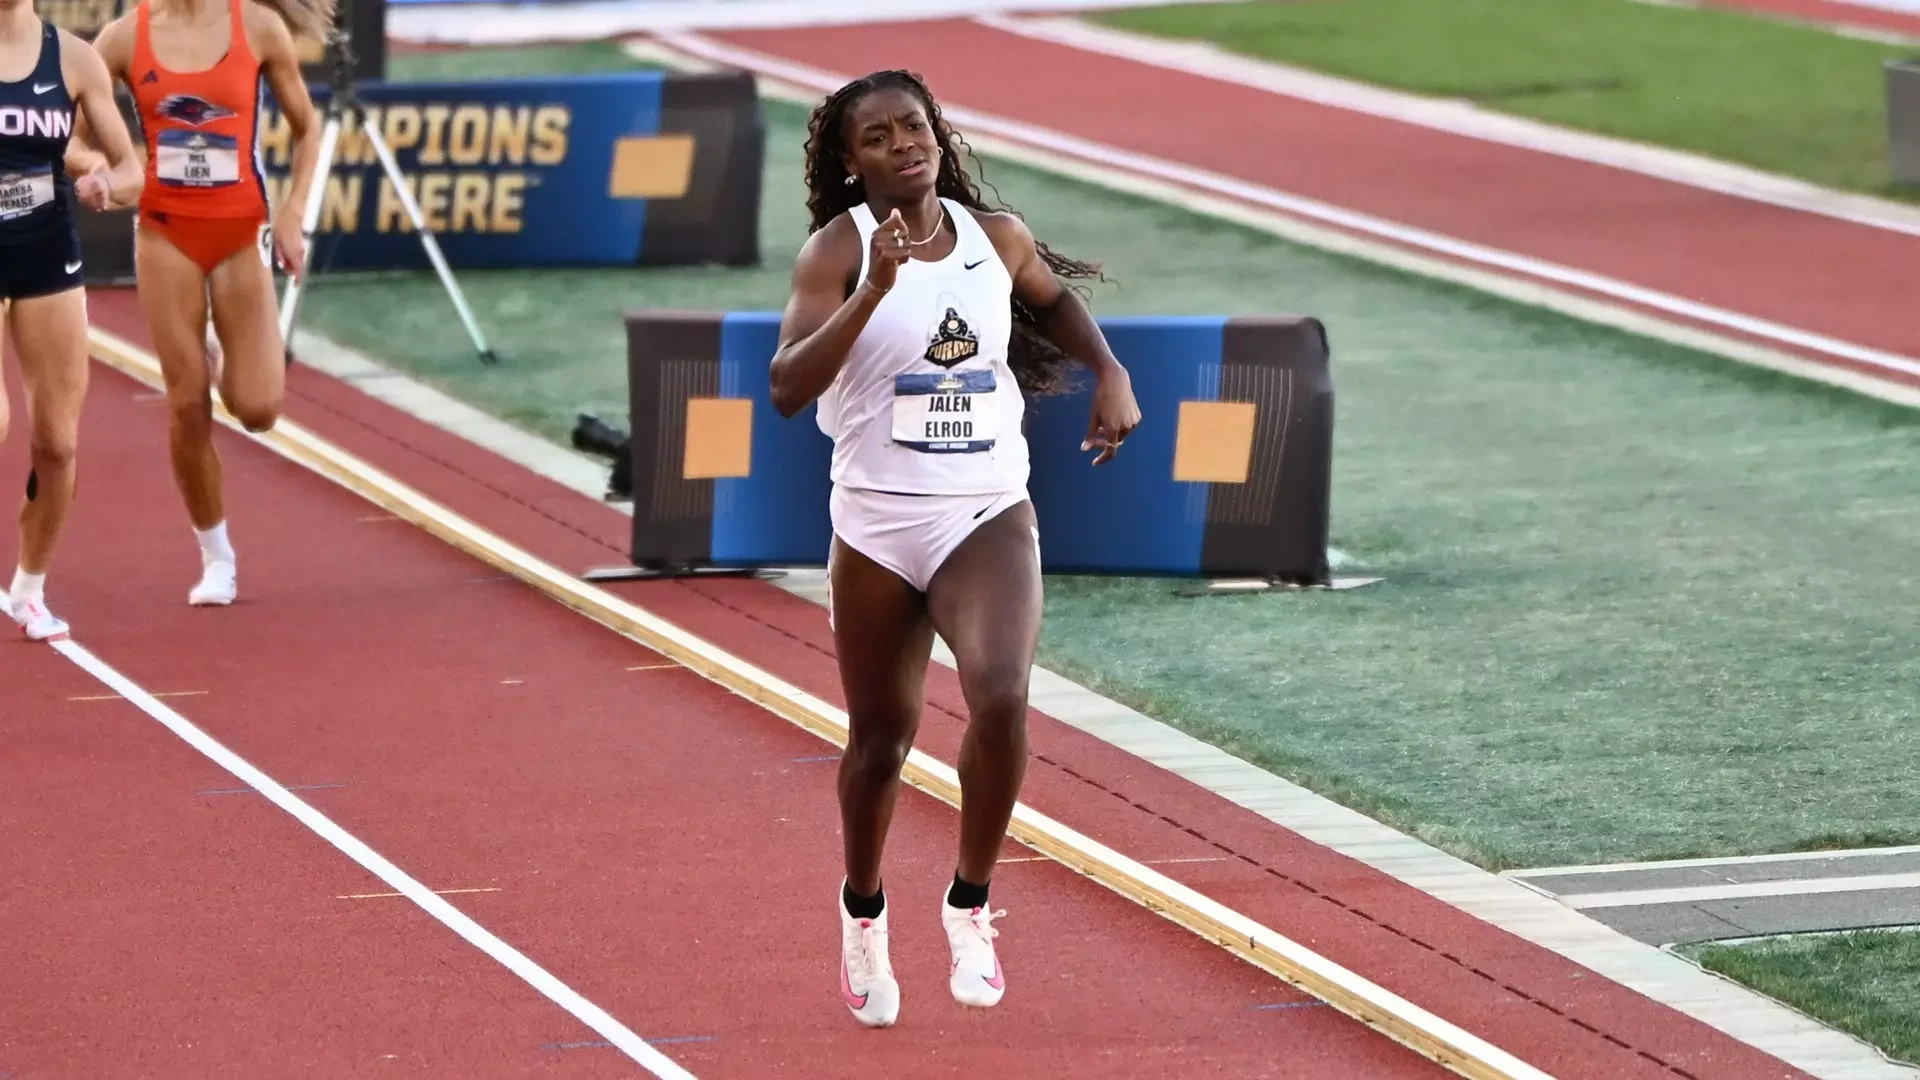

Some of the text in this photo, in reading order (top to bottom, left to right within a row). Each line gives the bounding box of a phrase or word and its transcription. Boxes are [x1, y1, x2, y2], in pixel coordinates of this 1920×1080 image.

[260, 105, 571, 166] HMPIONS
[184, 166, 211, 179] LIEN
[376, 172, 524, 233] HERE
[929, 340, 976, 361] PURDUE
[928, 396, 972, 412] JALEN
[925, 420, 973, 438] ELROD
